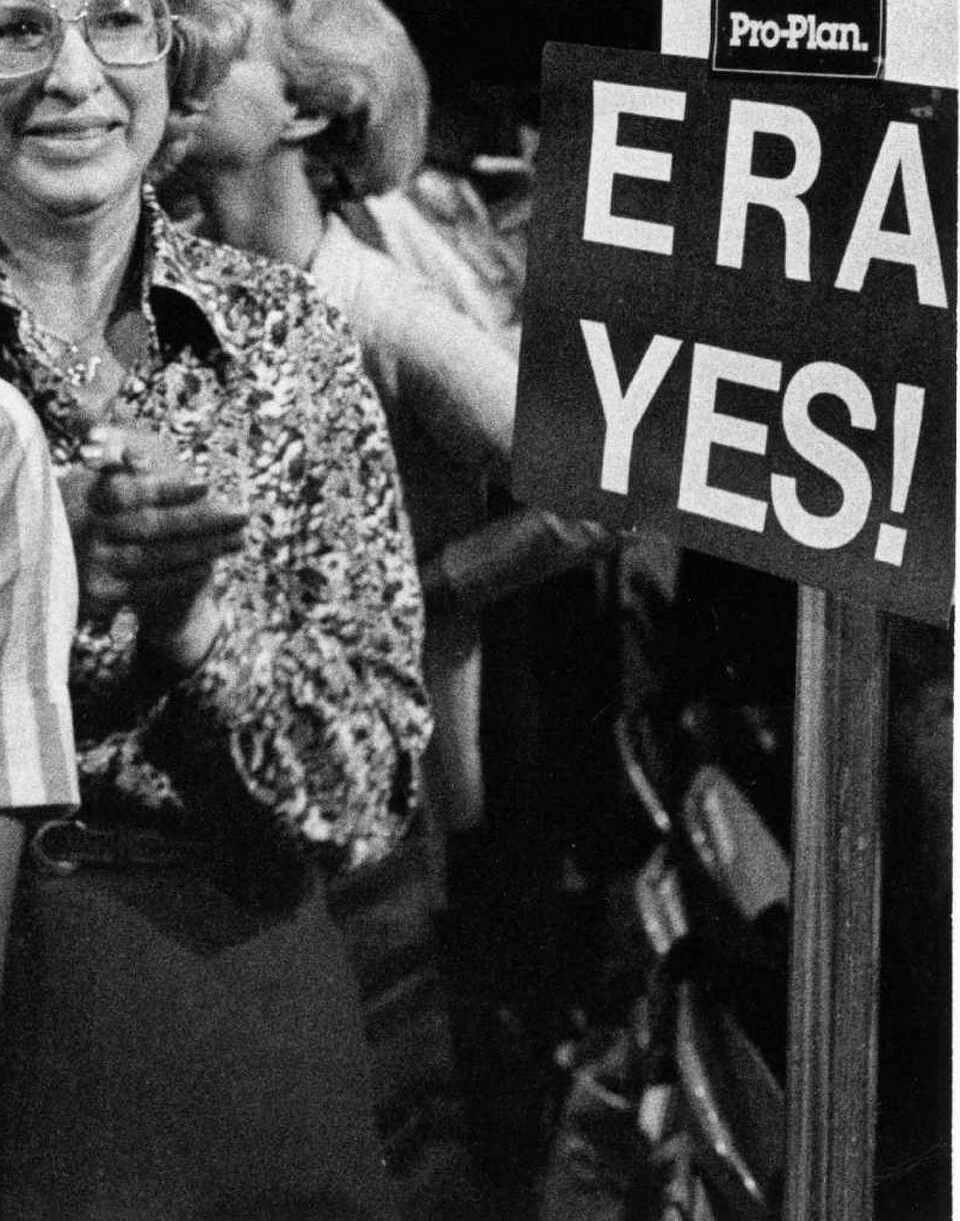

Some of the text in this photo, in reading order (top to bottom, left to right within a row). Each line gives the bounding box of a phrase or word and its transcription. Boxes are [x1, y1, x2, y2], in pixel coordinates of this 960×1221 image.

[729, 12, 869, 52] Pro-Plan.
[582, 80, 948, 309] ERA
[579, 319, 925, 567] YES!
